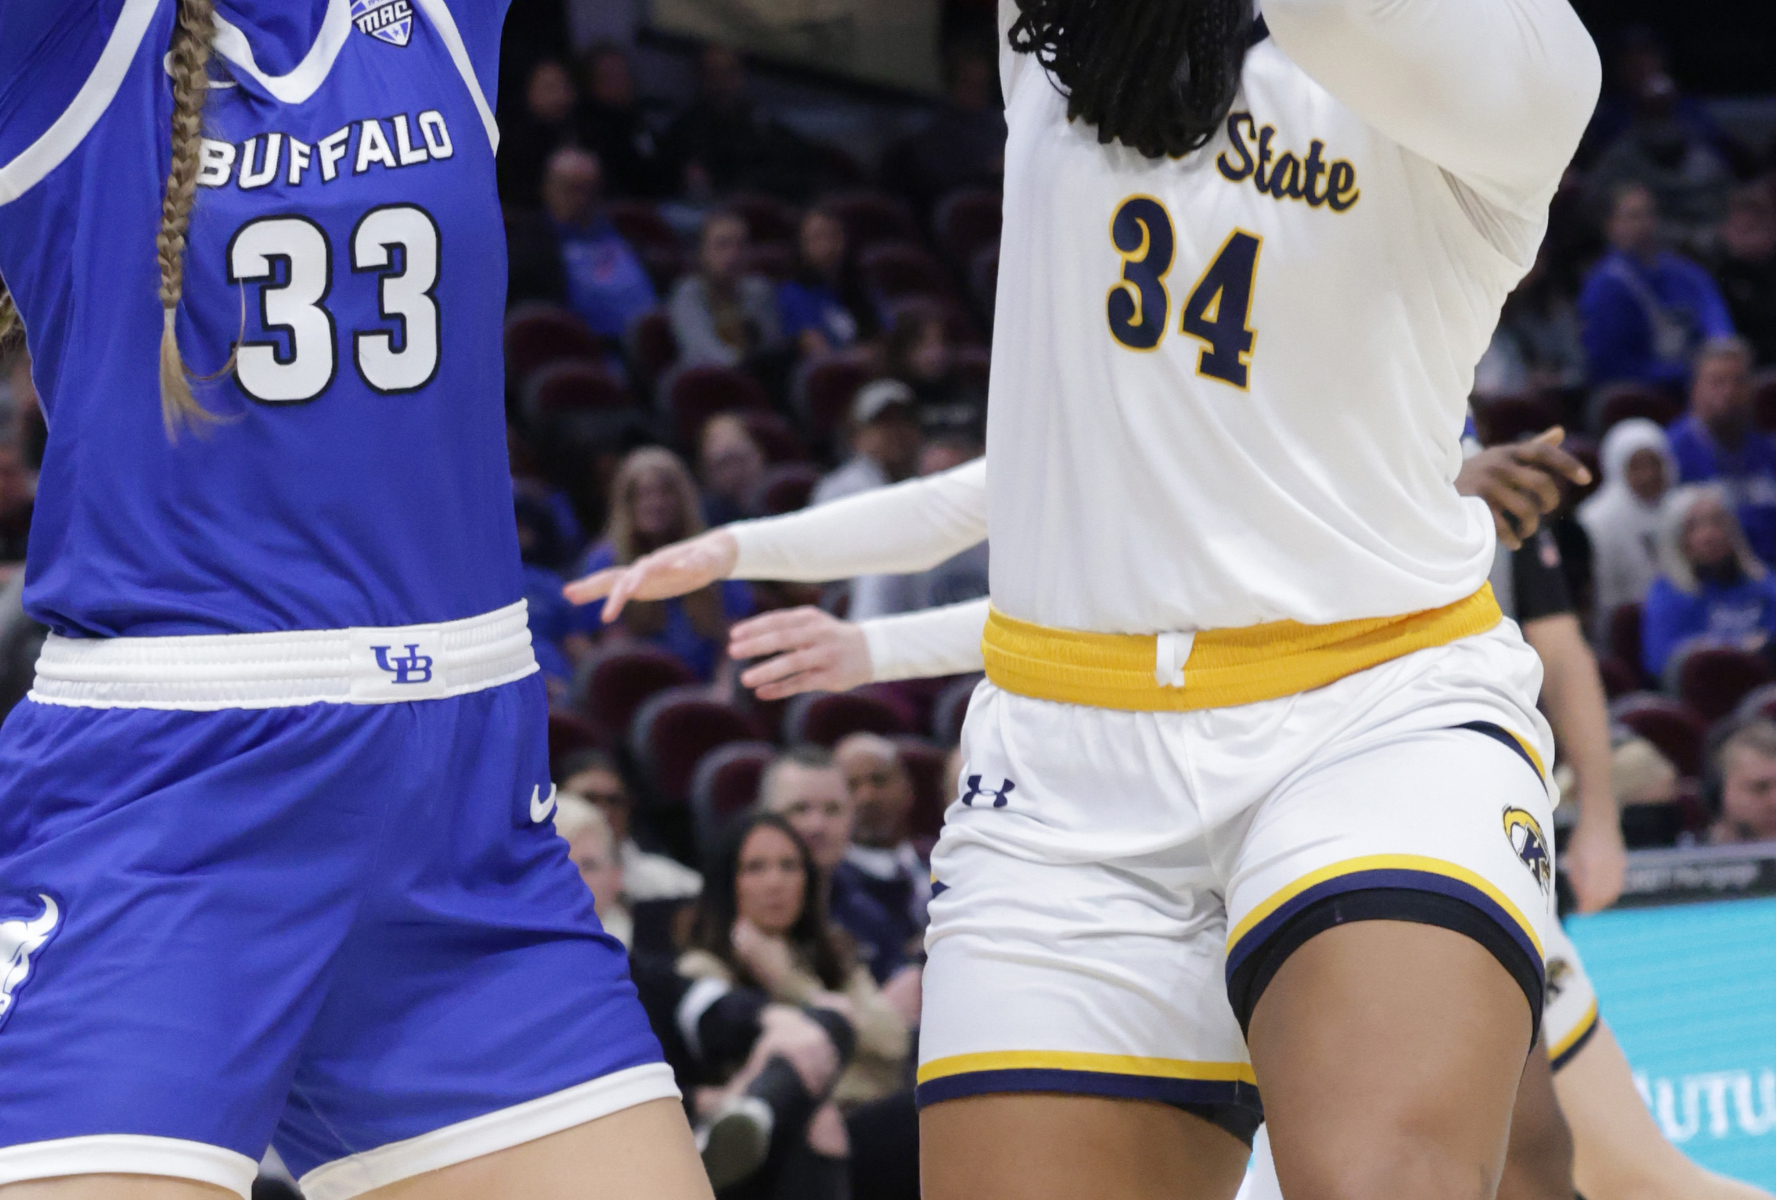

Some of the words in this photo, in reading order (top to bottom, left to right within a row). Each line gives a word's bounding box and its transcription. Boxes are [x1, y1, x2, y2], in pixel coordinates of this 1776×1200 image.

[356, 0, 413, 34] MAC
[196, 109, 454, 191] BUFFALO
[1216, 112, 1360, 212] State
[228, 204, 442, 403] 33
[1107, 193, 1263, 392] 34
[370, 644, 433, 684] UB
